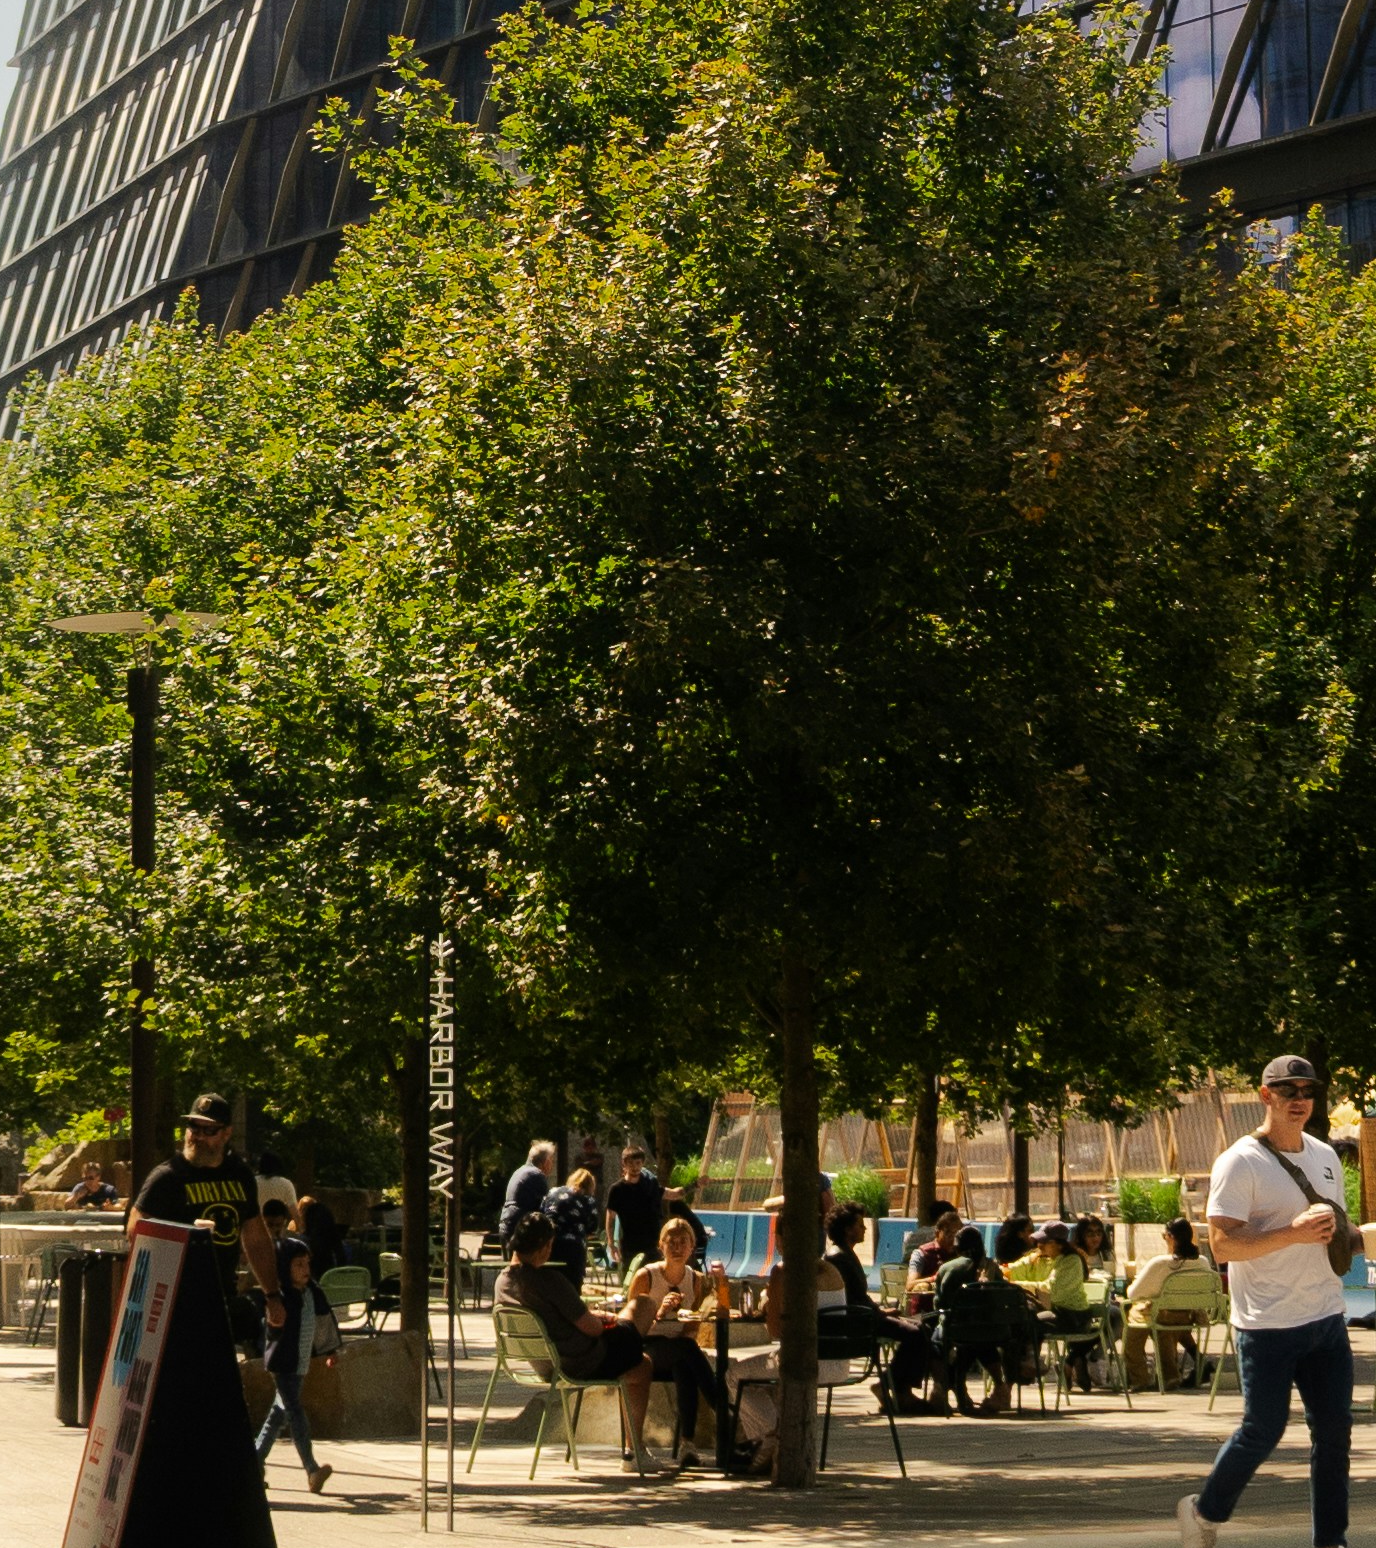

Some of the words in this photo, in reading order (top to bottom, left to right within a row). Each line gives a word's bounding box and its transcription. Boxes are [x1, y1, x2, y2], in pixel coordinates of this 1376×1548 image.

[429, 976, 454, 1111] HARBOR
[185, 1180, 247, 1204] NIRVANA
[429, 1121, 454, 1199] WAY
